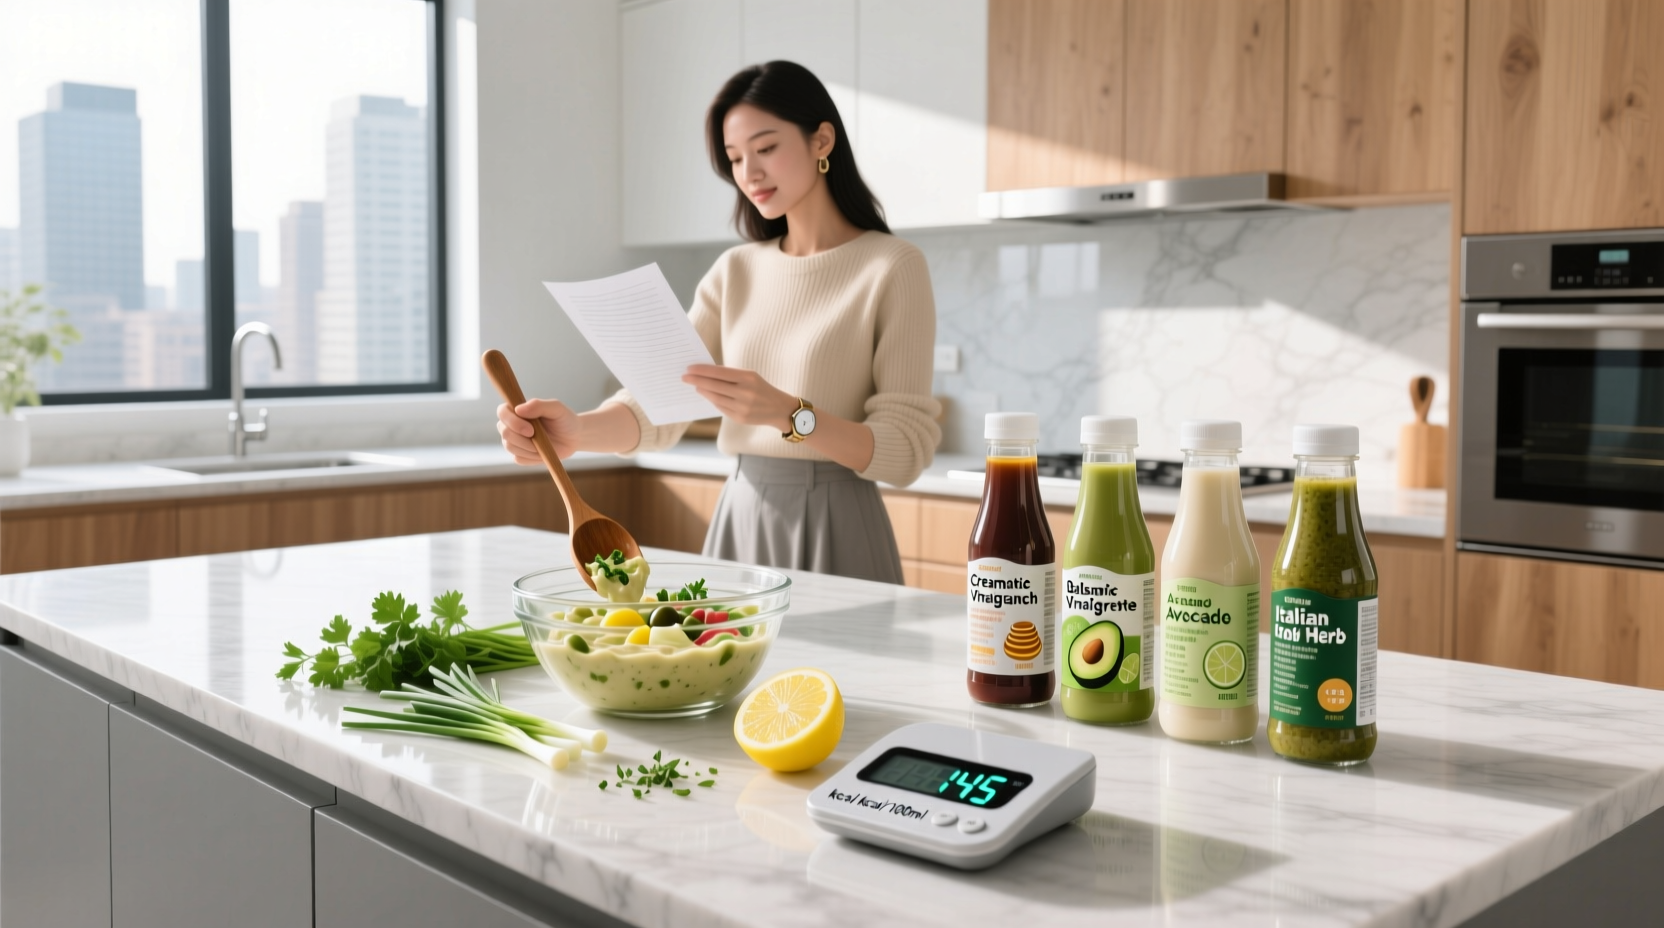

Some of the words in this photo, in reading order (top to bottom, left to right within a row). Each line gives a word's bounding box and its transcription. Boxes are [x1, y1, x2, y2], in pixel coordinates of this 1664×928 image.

[1166, 606, 1232, 625] Avocado
[1275, 604, 1329, 626] Italian
[1305, 626, 1347, 645] Herb
[938, 769, 1008, 805] 145
